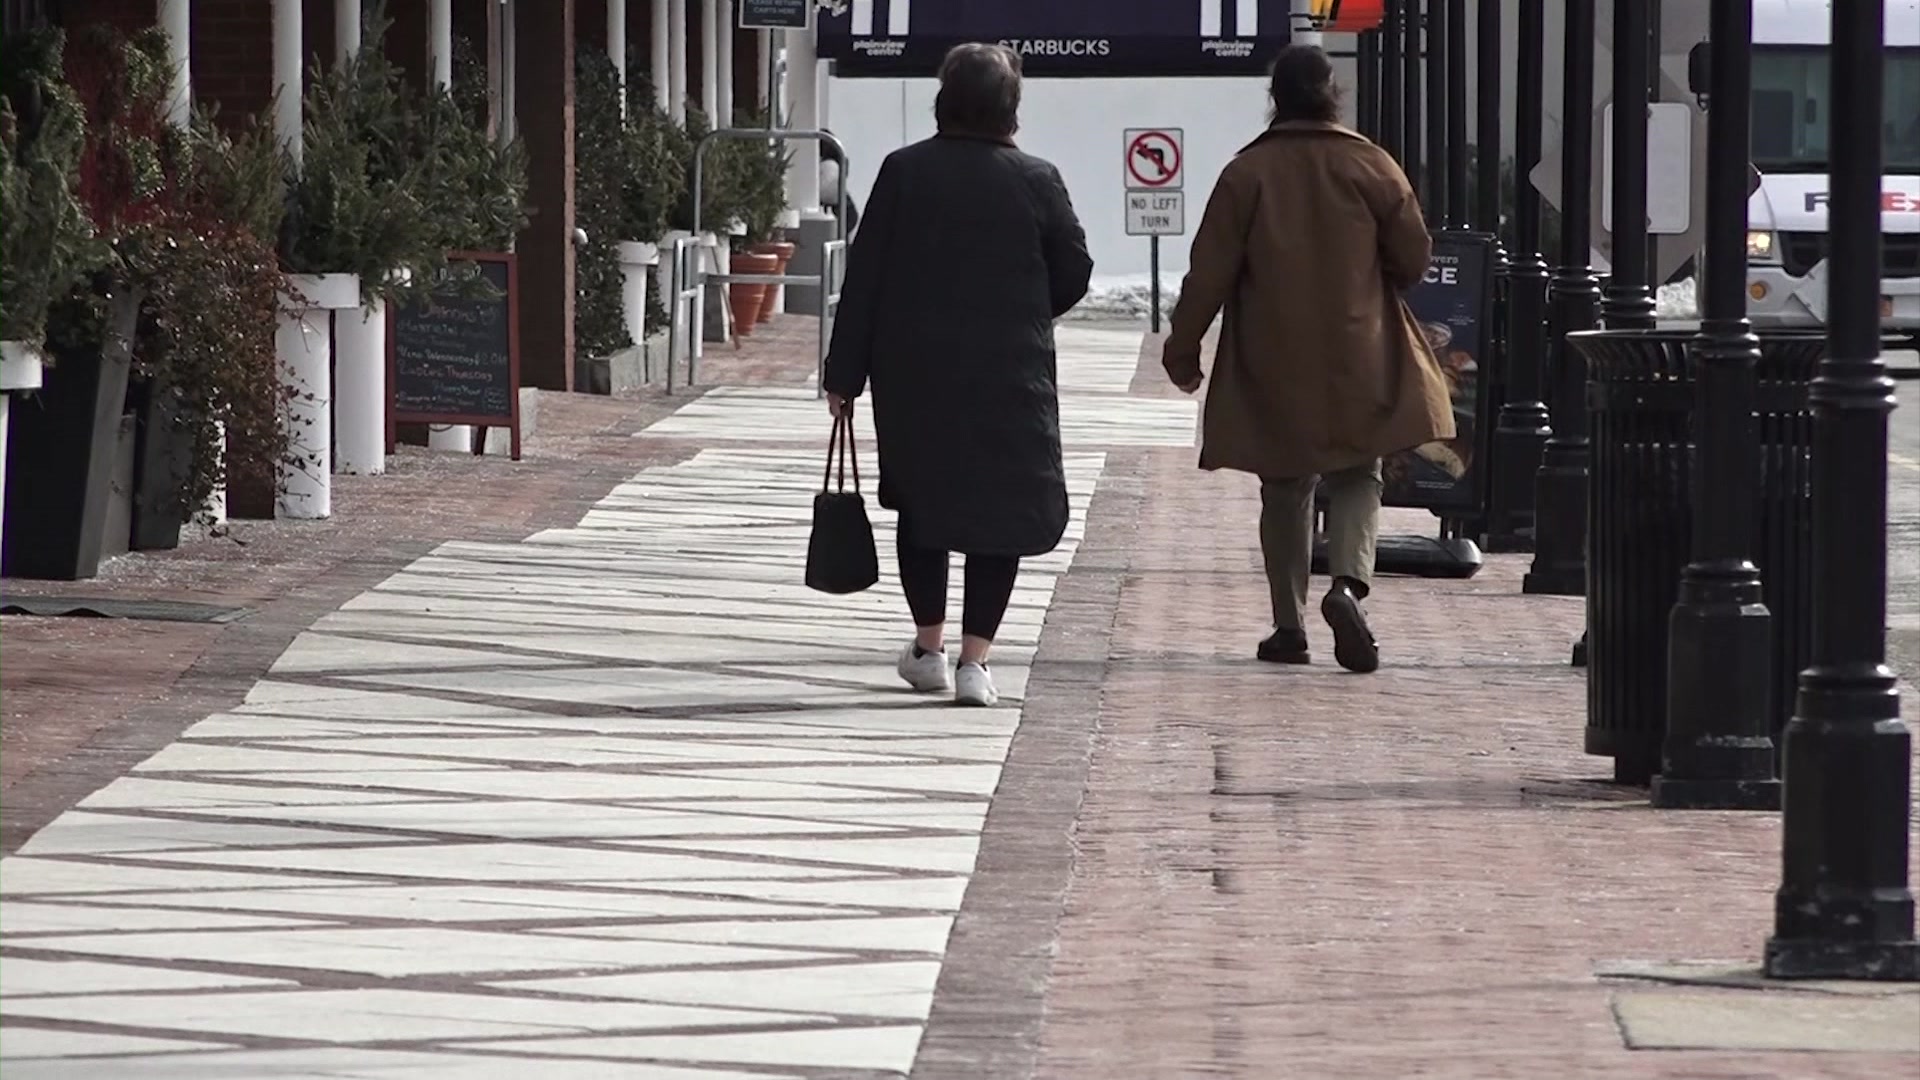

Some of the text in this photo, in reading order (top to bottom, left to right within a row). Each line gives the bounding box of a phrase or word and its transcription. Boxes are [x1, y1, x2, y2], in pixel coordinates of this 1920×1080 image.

[853, 39, 906, 51] plainview
[1202, 39, 1255, 51] plainview
[866, 47, 903, 56] centre
[1215, 48, 1251, 57] centre
[1131, 198, 1177, 210] NO LEFT
[1141, 216, 1170, 228] TURN
